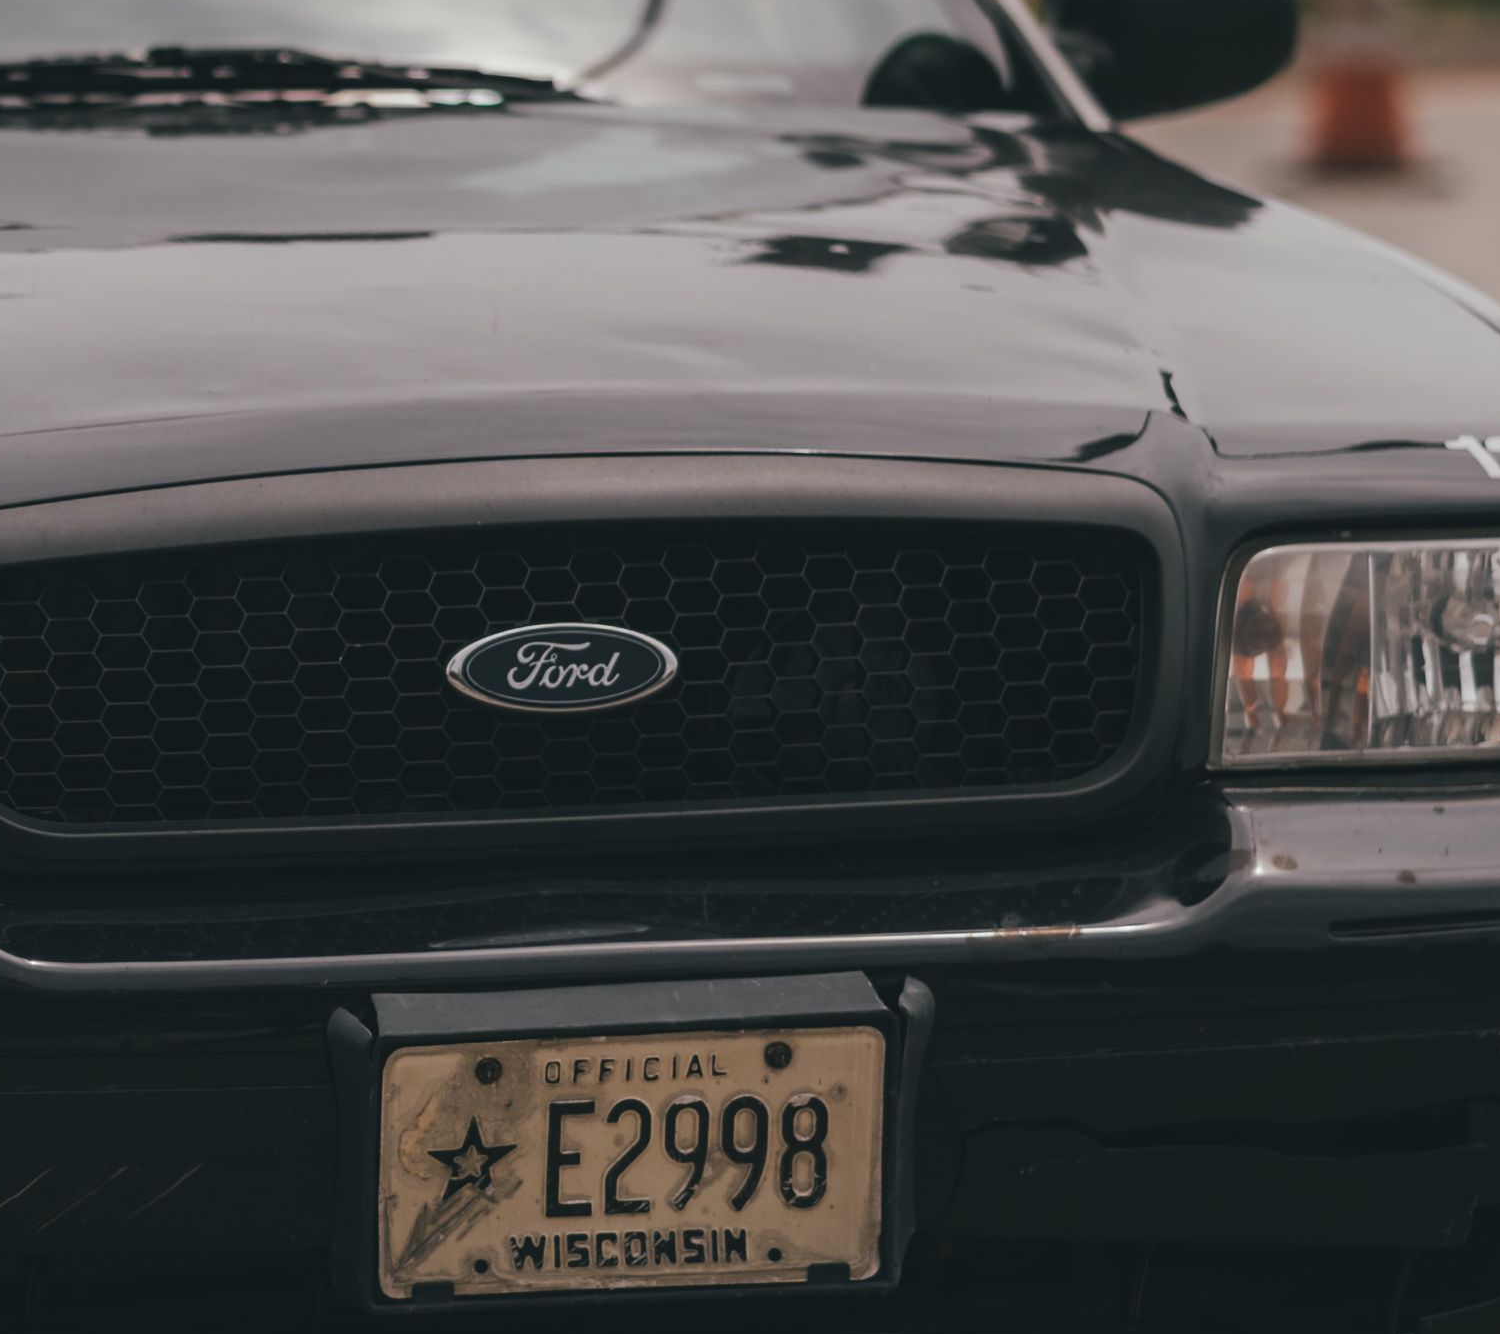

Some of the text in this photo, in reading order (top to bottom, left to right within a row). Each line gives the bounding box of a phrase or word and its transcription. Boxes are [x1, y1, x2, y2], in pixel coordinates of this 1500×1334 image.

[506, 641, 621, 690] Ford
[544, 1052, 728, 1085] OFFICIAL
[544, 1094, 829, 1218] E2998
[509, 1227, 749, 1270] WISCONSIN
